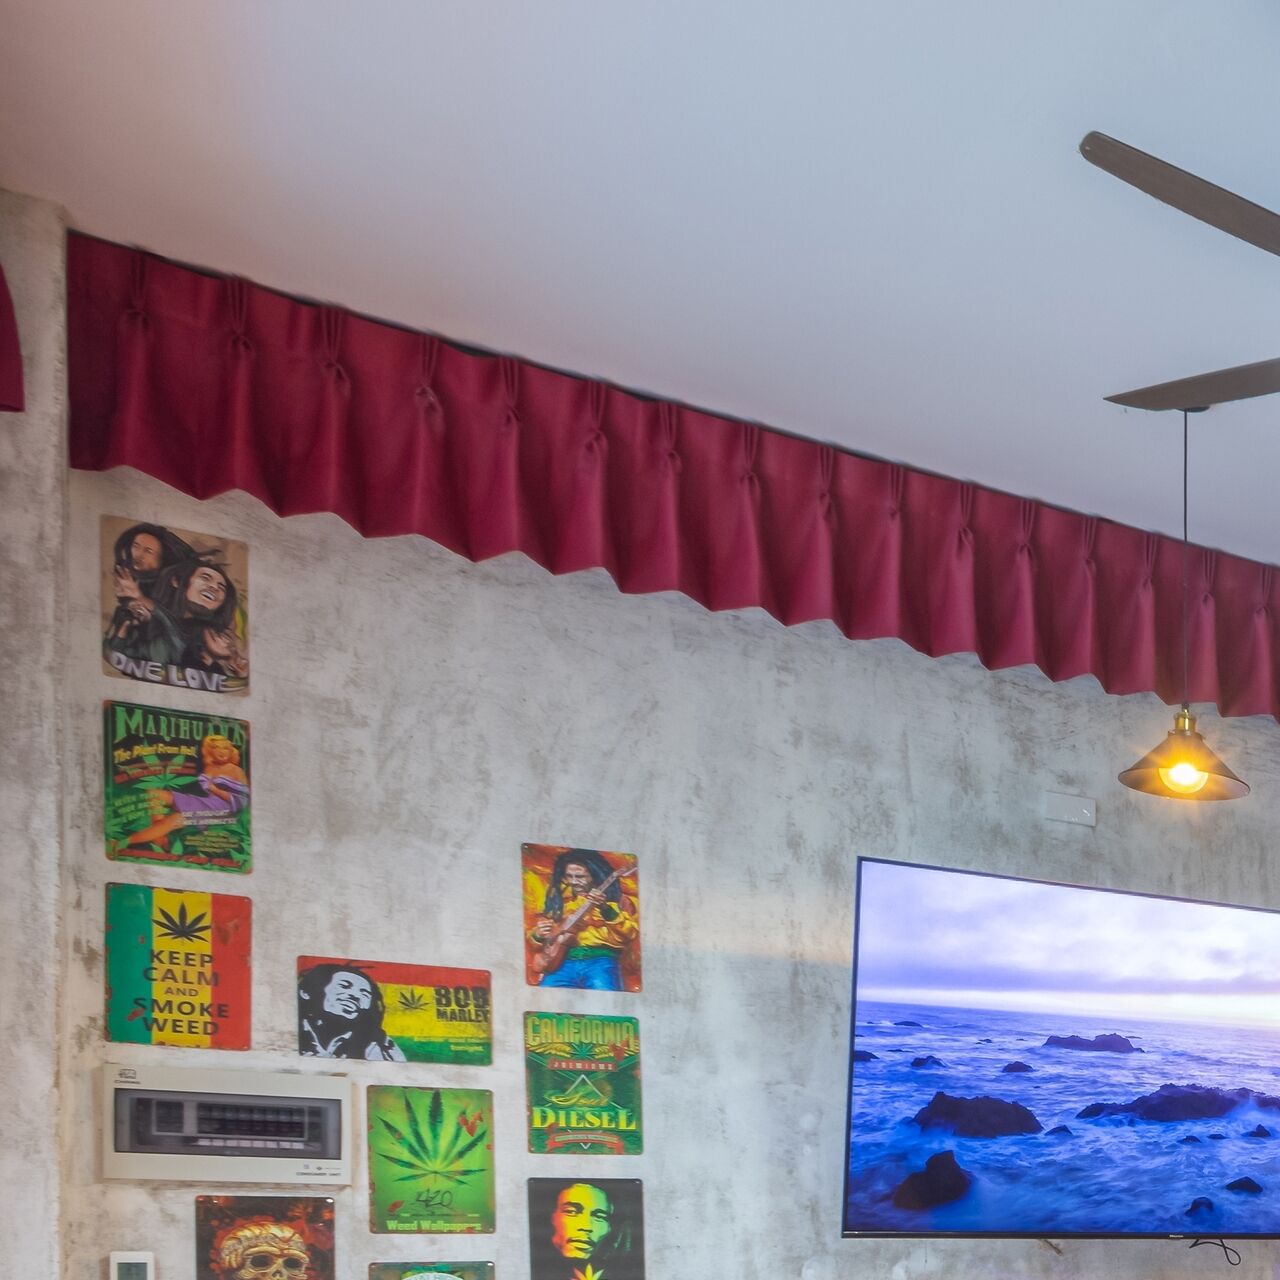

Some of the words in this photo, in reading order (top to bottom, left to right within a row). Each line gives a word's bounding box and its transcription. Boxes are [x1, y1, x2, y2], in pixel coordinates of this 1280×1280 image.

[110, 651, 162, 682] ONE
[167, 665, 238, 692] LOVE
[113, 706, 247, 746] MARIHUANA
[151, 949, 213, 968] KEEP
[143, 967, 220, 987] CALM
[164, 986, 199, 997] AND
[434, 985, 490, 1008] BOB
[133, 997, 229, 1018] SMOKE
[436, 1008, 490, 1022] MARLEY
[143, 1017, 219, 1035] WEED
[527, 1017, 635, 1051] CALIFORNIA
[532, 1106, 636, 1130] DIESEL
[415, 1188, 453, 1209] 420
[386, 1220, 418, 1231] Weed
